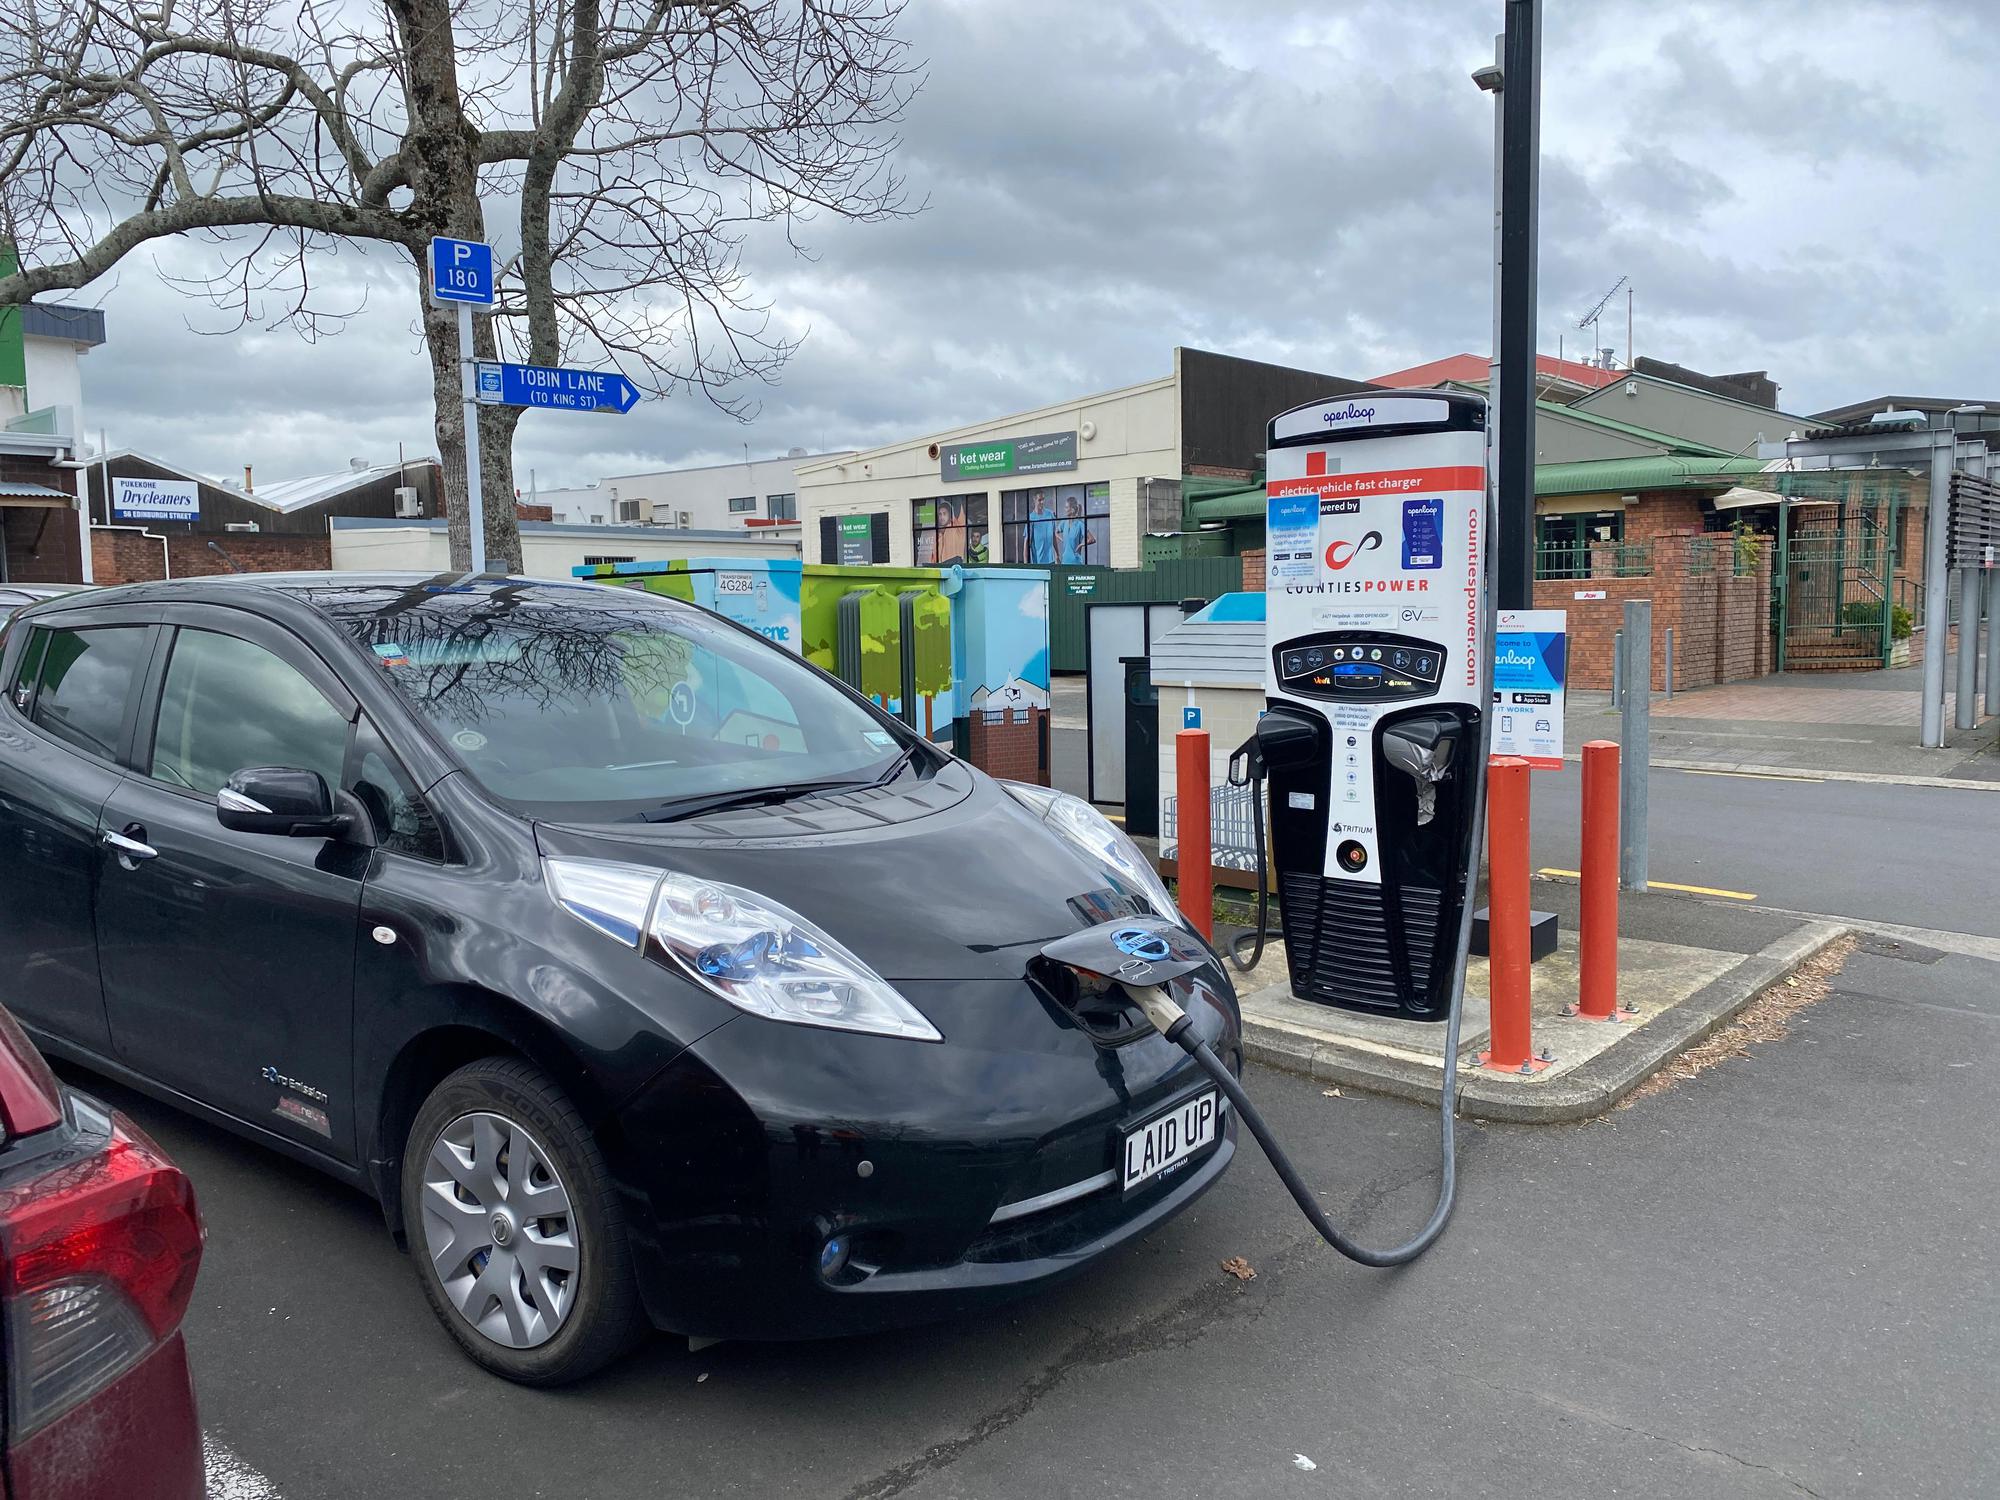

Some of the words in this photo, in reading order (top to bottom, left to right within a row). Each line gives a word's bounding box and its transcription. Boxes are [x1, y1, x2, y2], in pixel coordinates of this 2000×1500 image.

[454, 243, 472, 266] P
[449, 269, 477, 288] 180
[518, 368, 560, 388] TOBIN
[568, 373, 606, 393] LANE
[530, 390, 548, 404] (TO
[553, 392, 576, 405] KING
[580, 395, 597, 409] ST)
[1323, 403, 1376, 427] openloop
[979, 450, 1006, 462] wear
[120, 480, 157, 489] PUKEKOHE
[1279, 485, 1314, 496] electric
[1317, 480, 1352, 493] vehicle
[1355, 479, 1376, 490] fast
[1378, 477, 1423, 490] charger
[122, 489, 192, 507] Drycleaners
[1320, 502, 1345, 512] wered
[1347, 501, 1358, 512] by
[132, 511, 168, 519] EDINBURGH
[169, 512, 192, 520] STREET
[1407, 504, 1438, 517] openloop
[720, 579, 753, 592] 4G284
[1463, 508, 1479, 687] countiespower.com
[1495, 649, 1536, 671] enloop
[1187, 711, 1196, 721] P
[1343, 825, 1373, 834] TRITIUM
[1127, 1117, 1177, 1182] LAID
[1185, 1098, 1212, 1147] UP
